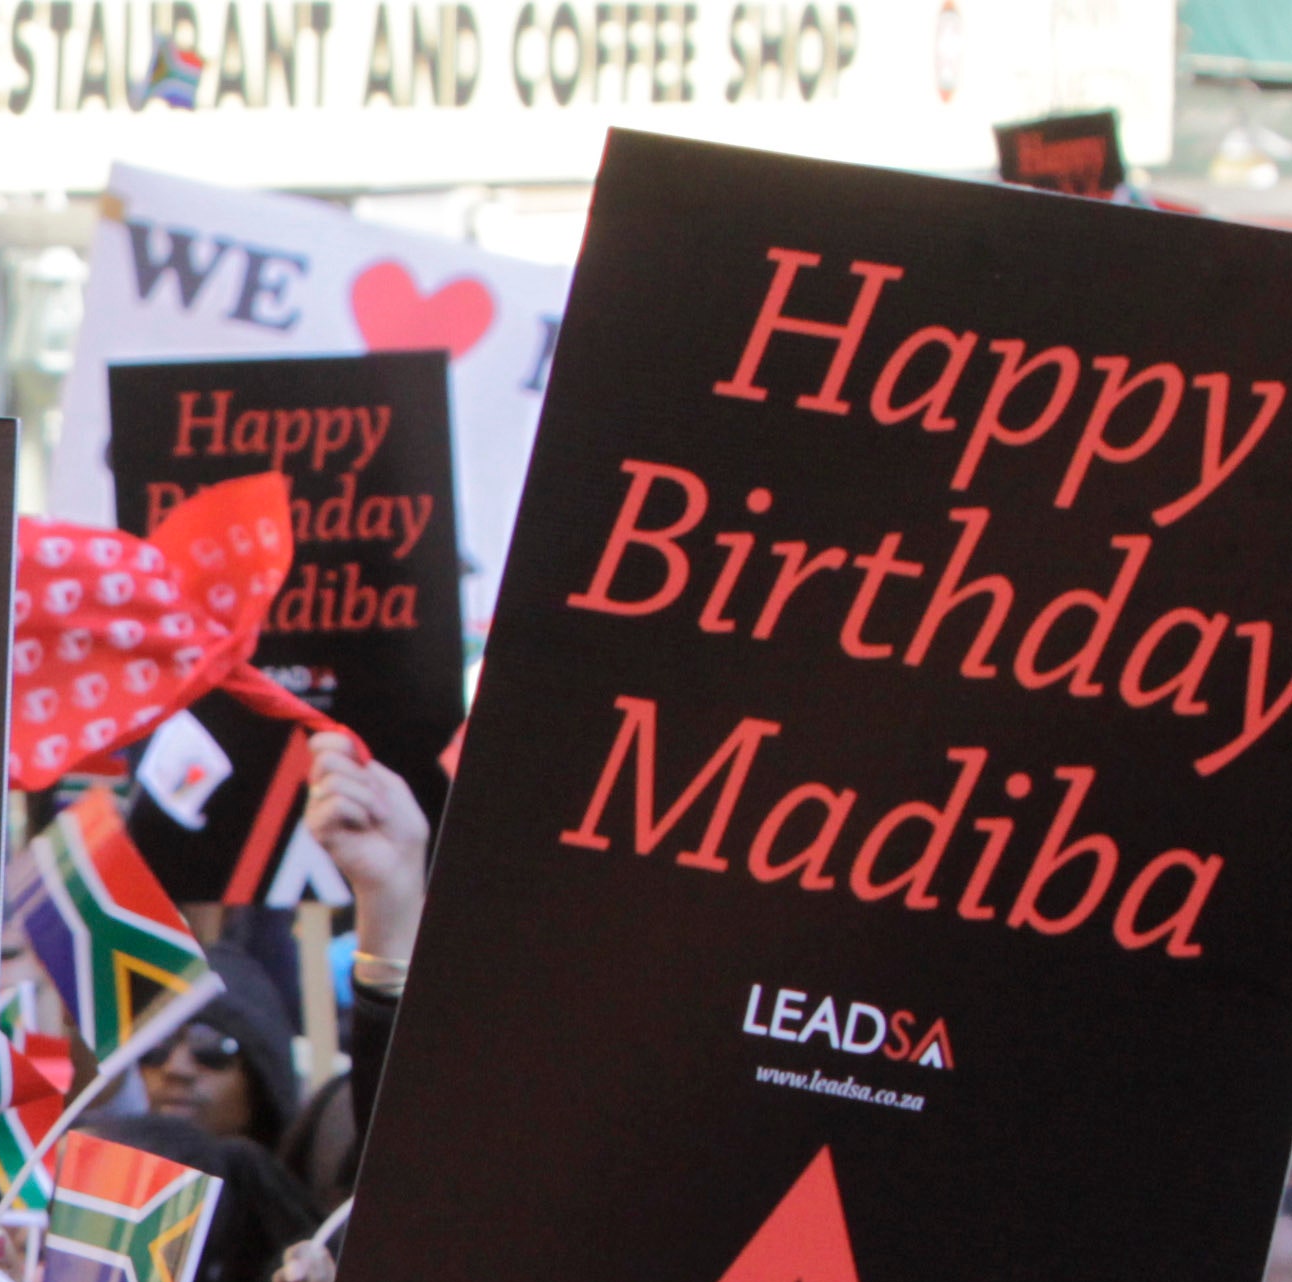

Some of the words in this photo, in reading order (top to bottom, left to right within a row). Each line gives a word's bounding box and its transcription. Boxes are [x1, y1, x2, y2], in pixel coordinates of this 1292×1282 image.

[362, 2, 481, 107] AND
[512, 2, 694, 107] COFFEE
[727, 2, 858, 102] SHOP
[124, 218, 309, 332] WE
[173, 390, 392, 471] Happy
[713, 247, 1286, 526] Happy
[567, 459, 1292, 776] Birthday
[560, 695, 1223, 957] Madiba
[742, 983, 955, 1070] LEADSA
[755, 1065, 924, 1111] www.leadsa.co.za
